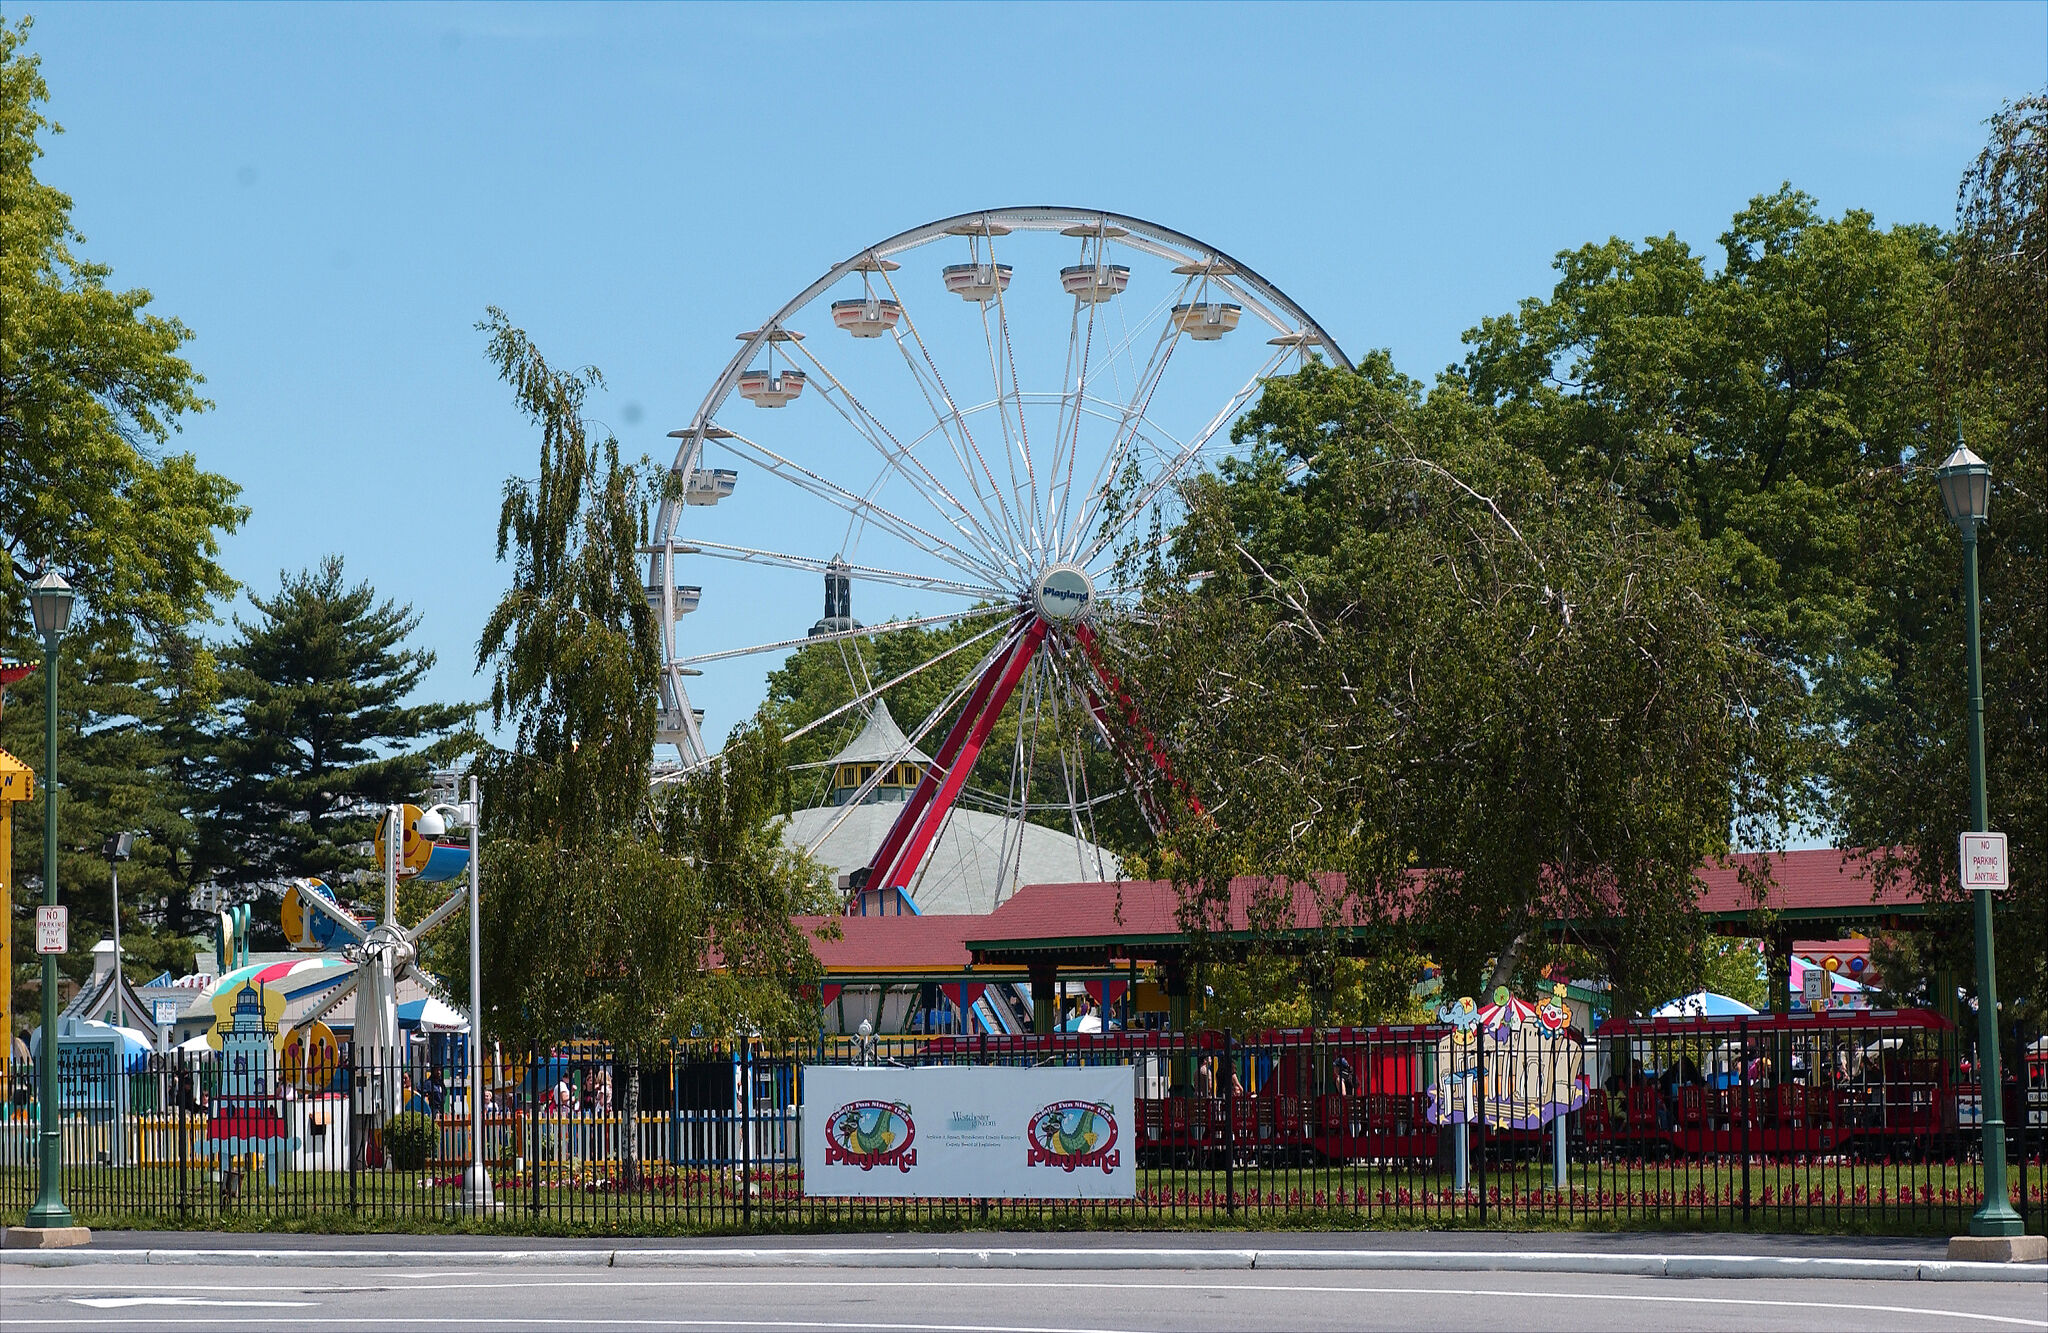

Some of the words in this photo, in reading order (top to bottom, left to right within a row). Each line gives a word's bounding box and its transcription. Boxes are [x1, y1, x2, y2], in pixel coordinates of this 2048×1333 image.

[1043, 586, 1089, 602] Playland
[1981, 840, 1990, 850] NO
[1973, 856, 1998, 866] PARKING
[1974, 872, 1999, 881] ANYTIME
[46, 911, 58, 920] NO
[76, 1046, 110, 1055] Leaving
[825, 1148, 917, 1173] Playland
[1028, 1149, 1120, 1174] Playland
